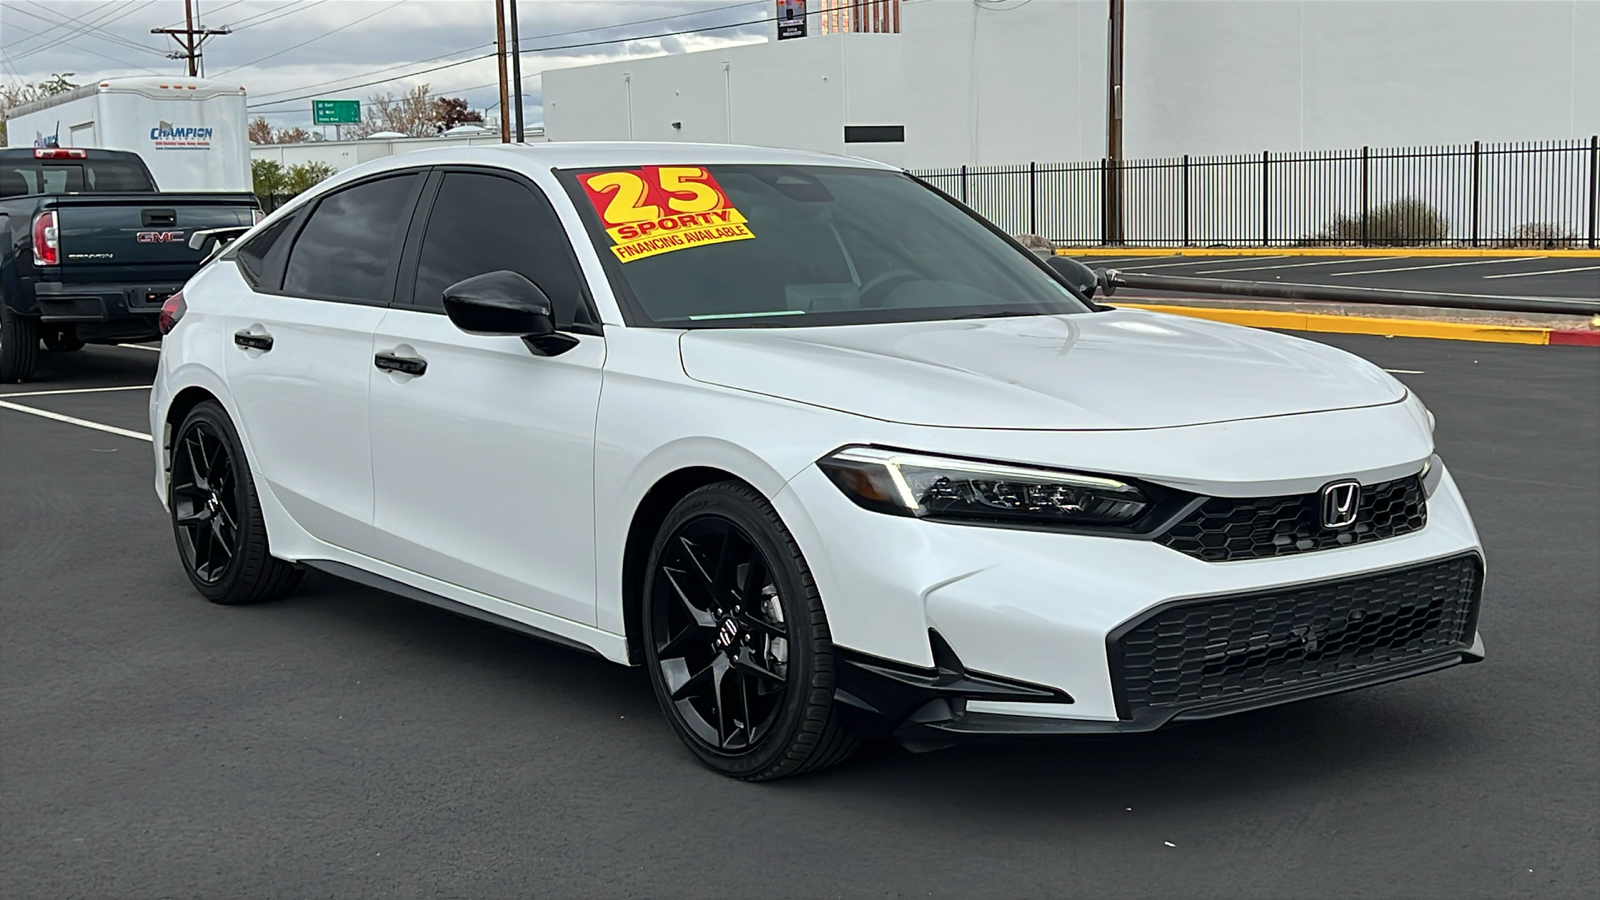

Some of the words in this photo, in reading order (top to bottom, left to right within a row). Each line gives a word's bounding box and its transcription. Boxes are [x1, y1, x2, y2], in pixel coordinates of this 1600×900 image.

[150, 127, 213, 140] CHAMPION
[587, 167, 724, 224] 25
[136, 231, 185, 243] GMC
[617, 210, 731, 240] SPORTY
[615, 234, 685, 259] FINANCING
[685, 225, 749, 244] AVAILABLE
